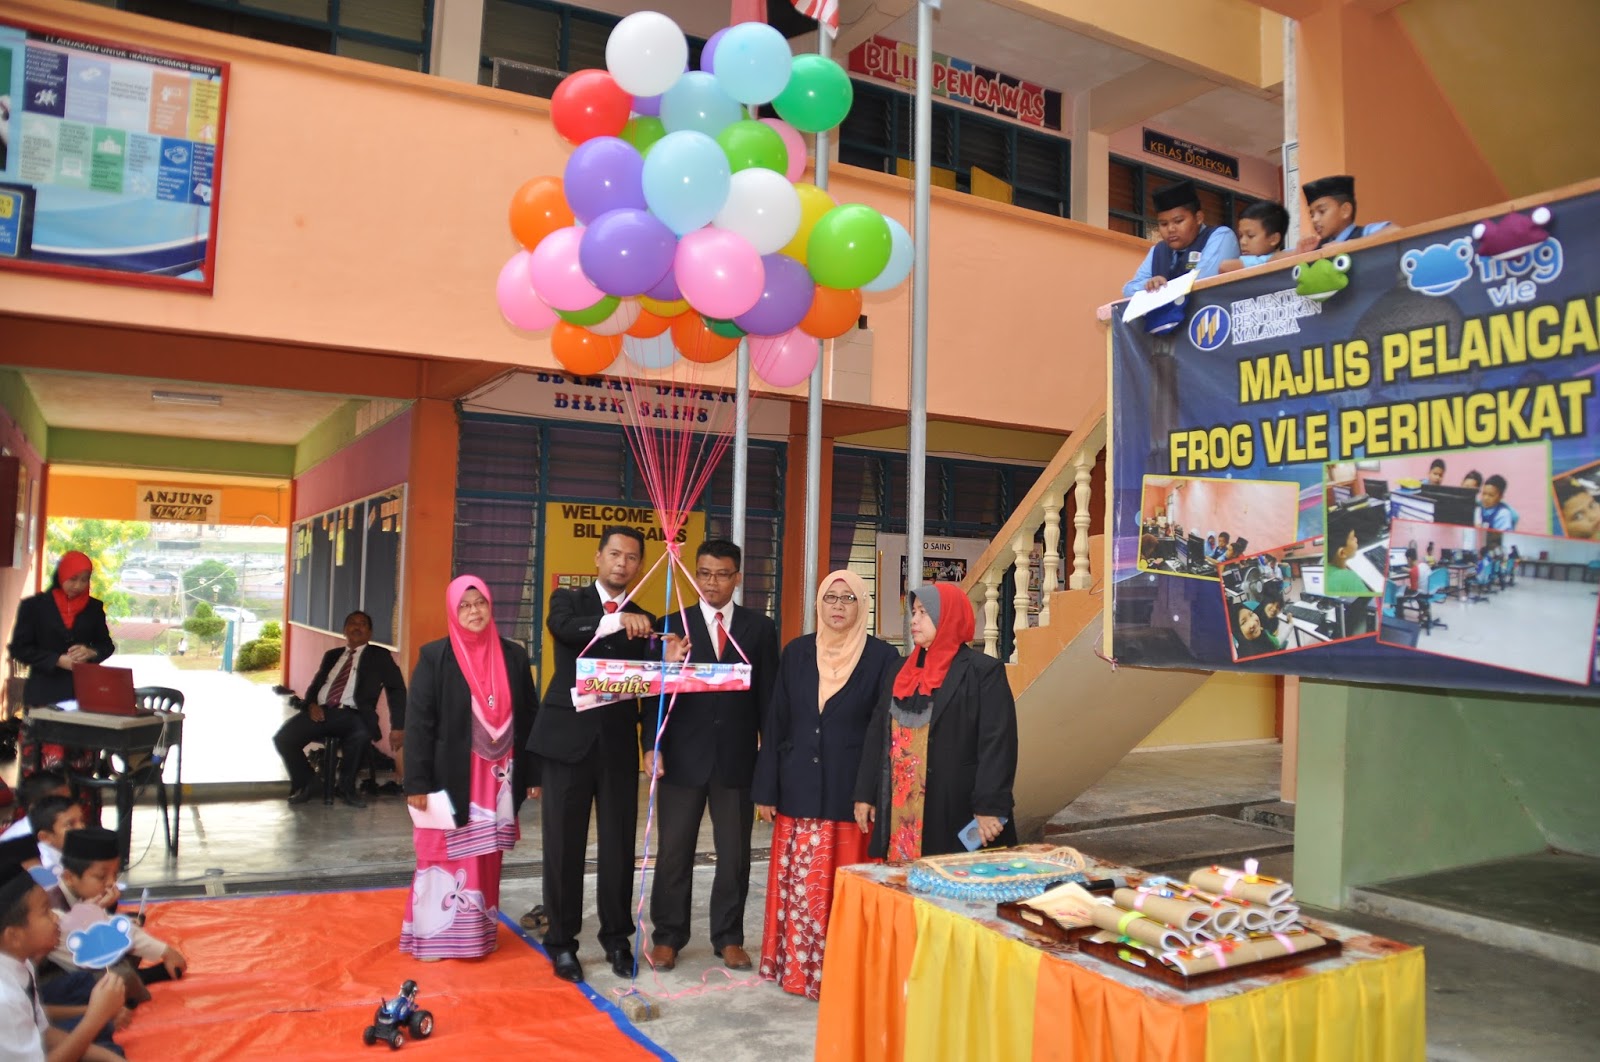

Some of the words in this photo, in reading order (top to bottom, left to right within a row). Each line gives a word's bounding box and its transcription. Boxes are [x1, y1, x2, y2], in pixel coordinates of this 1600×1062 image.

[865, 42, 918, 82] BILI
[932, 62, 1045, 120] PENGAWAS
[1150, 140, 1182, 160] KELAS
[1185, 152, 1233, 177] DISLEKSIA
[1487, 277, 1537, 307] vle
[1232, 300, 1322, 329] PENDIDIKAN
[1232, 318, 1301, 345] MALAYSIA
[1239, 339, 1370, 403] MAJLIS
[1382, 294, 1600, 381] PELANCA
[554, 392, 624, 413] BILIK
[639, 401, 708, 422] SAINS
[1170, 424, 1253, 472] FROG
[1262, 414, 1328, 465] VLE
[1341, 379, 1592, 457] PERINGKAT
[144, 490, 214, 506] ANJUNG
[561, 504, 654, 524] WELCOME
[930, 542, 951, 551] SAINS
[584, 674, 650, 694] Majlis
